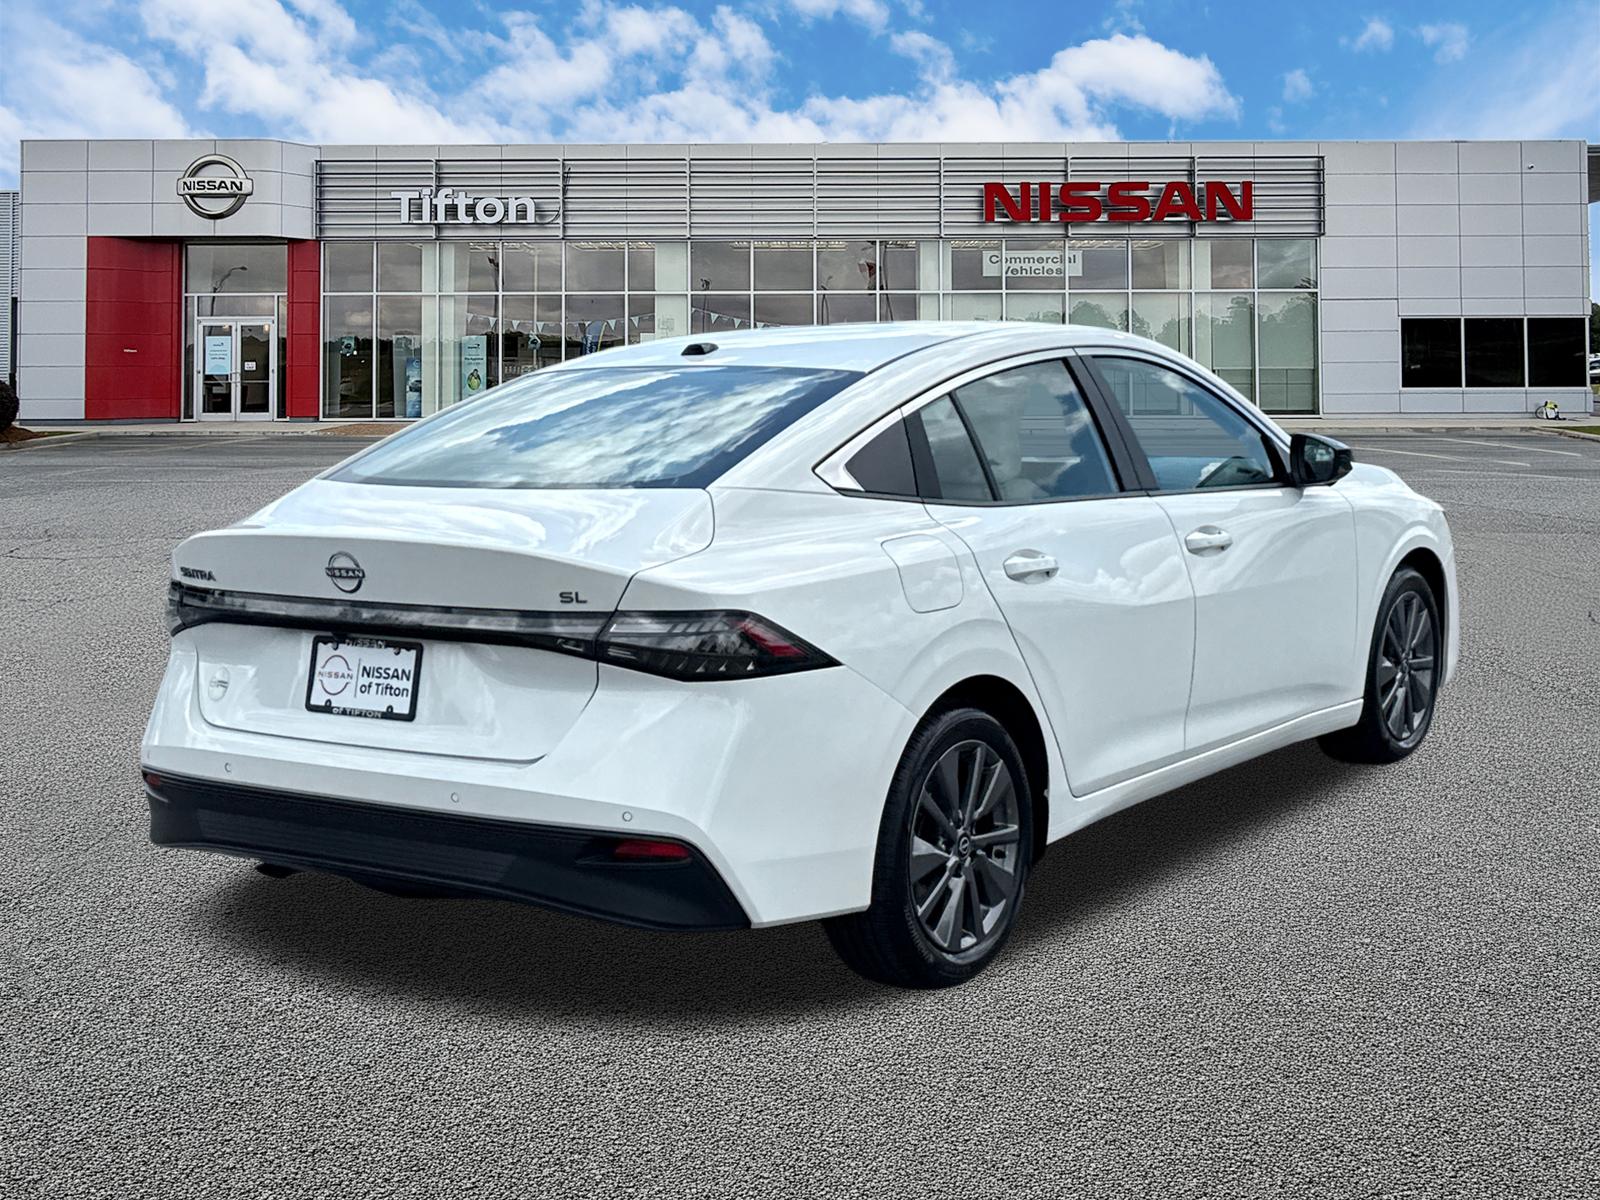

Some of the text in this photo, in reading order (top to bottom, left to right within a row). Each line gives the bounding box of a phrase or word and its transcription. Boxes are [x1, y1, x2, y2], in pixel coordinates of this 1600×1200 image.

[182, 180, 243, 191] NISSAN
[391, 188, 535, 224] Tifton
[984, 181, 1253, 222] NISSAN
[325, 567, 364, 578] NISSAN
[559, 591, 588, 604] SL
[317, 670, 354, 680] NISSAN
[361, 665, 411, 682] NISSAN
[359, 681, 410, 698] of Tifton
